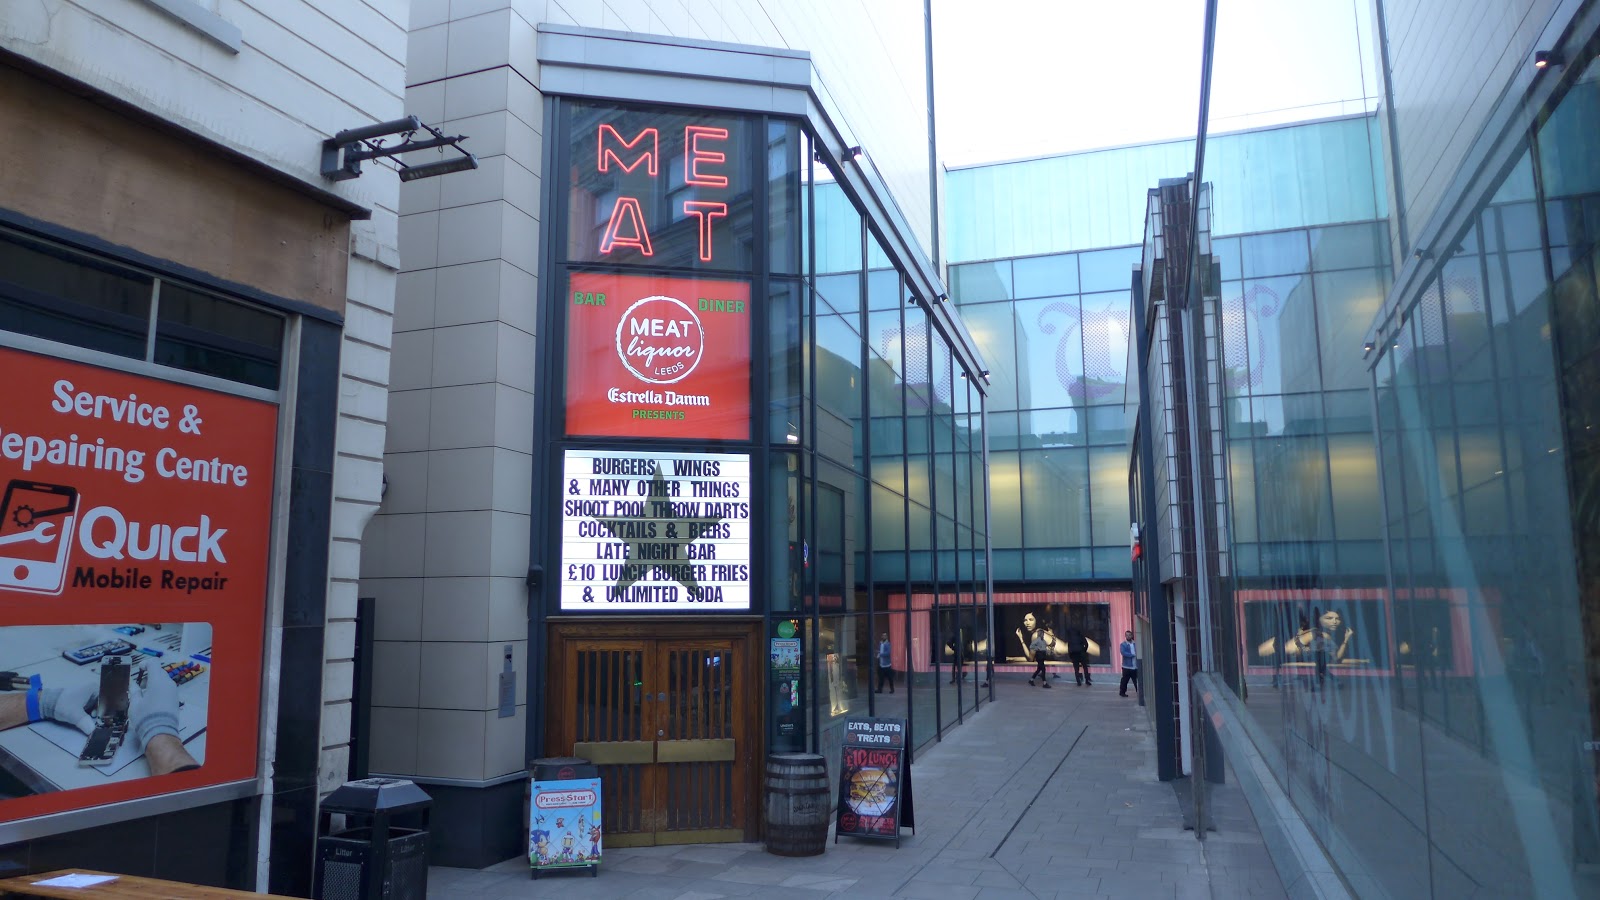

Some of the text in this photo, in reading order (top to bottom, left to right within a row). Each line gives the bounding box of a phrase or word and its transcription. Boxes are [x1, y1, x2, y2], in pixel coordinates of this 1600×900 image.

[573, 291, 607, 306] BAR
[698, 298, 746, 313] DINER
[630, 317, 693, 338] MEAT
[626, 336, 695, 367] liquor
[654, 361, 685, 375] LEEDS
[607, 387, 710, 406] Estrella Damm
[52, 379, 203, 435] Service &
[632, 409, 685, 420] PRESENTS
[0, 427, 248, 487] epairing Centre
[592, 457, 721, 477] BURGERS WINGS
[568, 478, 740, 498] & MANY OTHER THINGS
[564, 499, 749, 519] SHOOT POOL THROW DARTS
[79, 506, 228, 563] Quick
[578, 520, 731, 539] COCKTAILS & BEERS
[596, 542, 716, 560] LATE NIGHT BAR
[72, 567, 228, 594] Mobile Repair
[568, 563, 748, 582] £10 LUNCH BURGER FRIES
[582, 585, 724, 603] & UNLIMITED SODA
[848, 722, 901, 733] EATS, BEATS
[857, 734, 891, 743] TREATS
[335, 848, 353, 857] Litter
